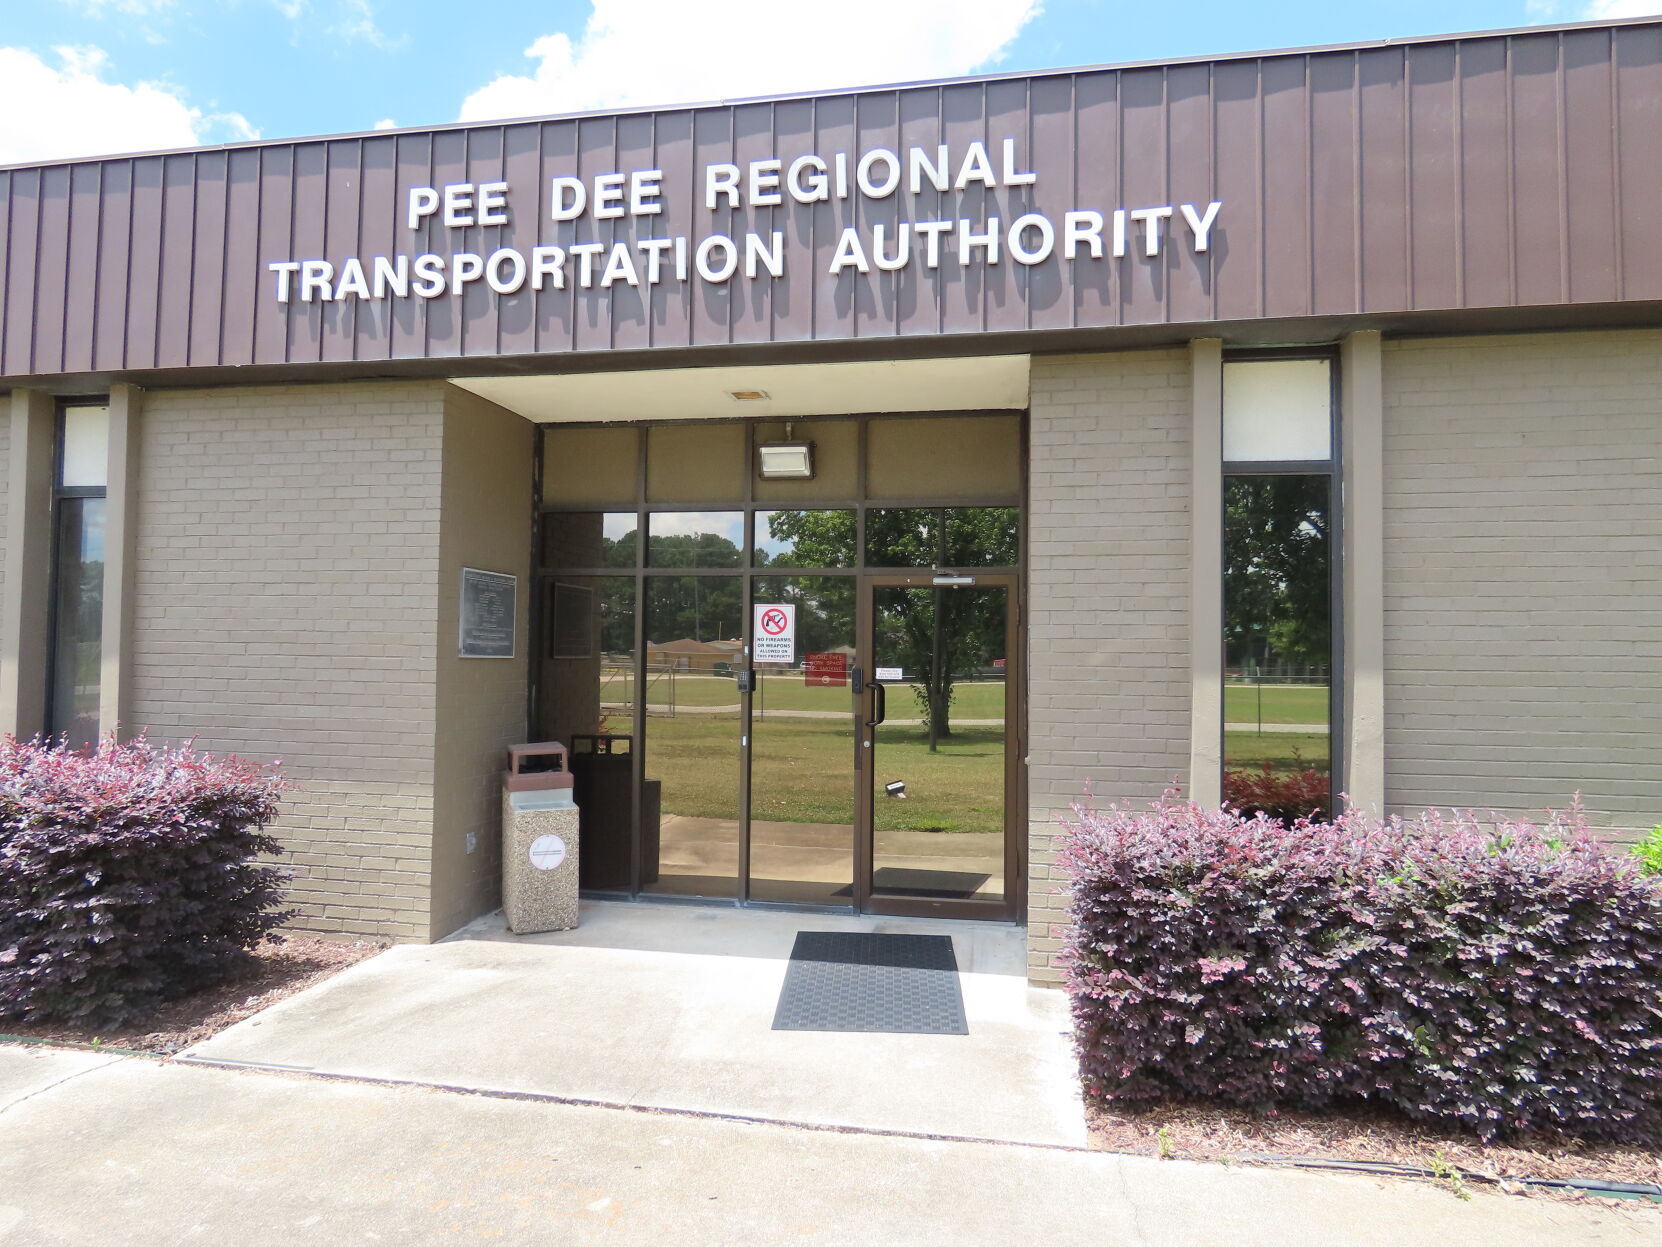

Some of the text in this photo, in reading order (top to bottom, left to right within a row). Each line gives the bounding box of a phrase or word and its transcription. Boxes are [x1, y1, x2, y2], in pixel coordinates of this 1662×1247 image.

[407, 138, 1037, 230] PEE DEE REGIONAL
[268, 201, 1223, 303] TRANSPORTATION AUTHORITY
